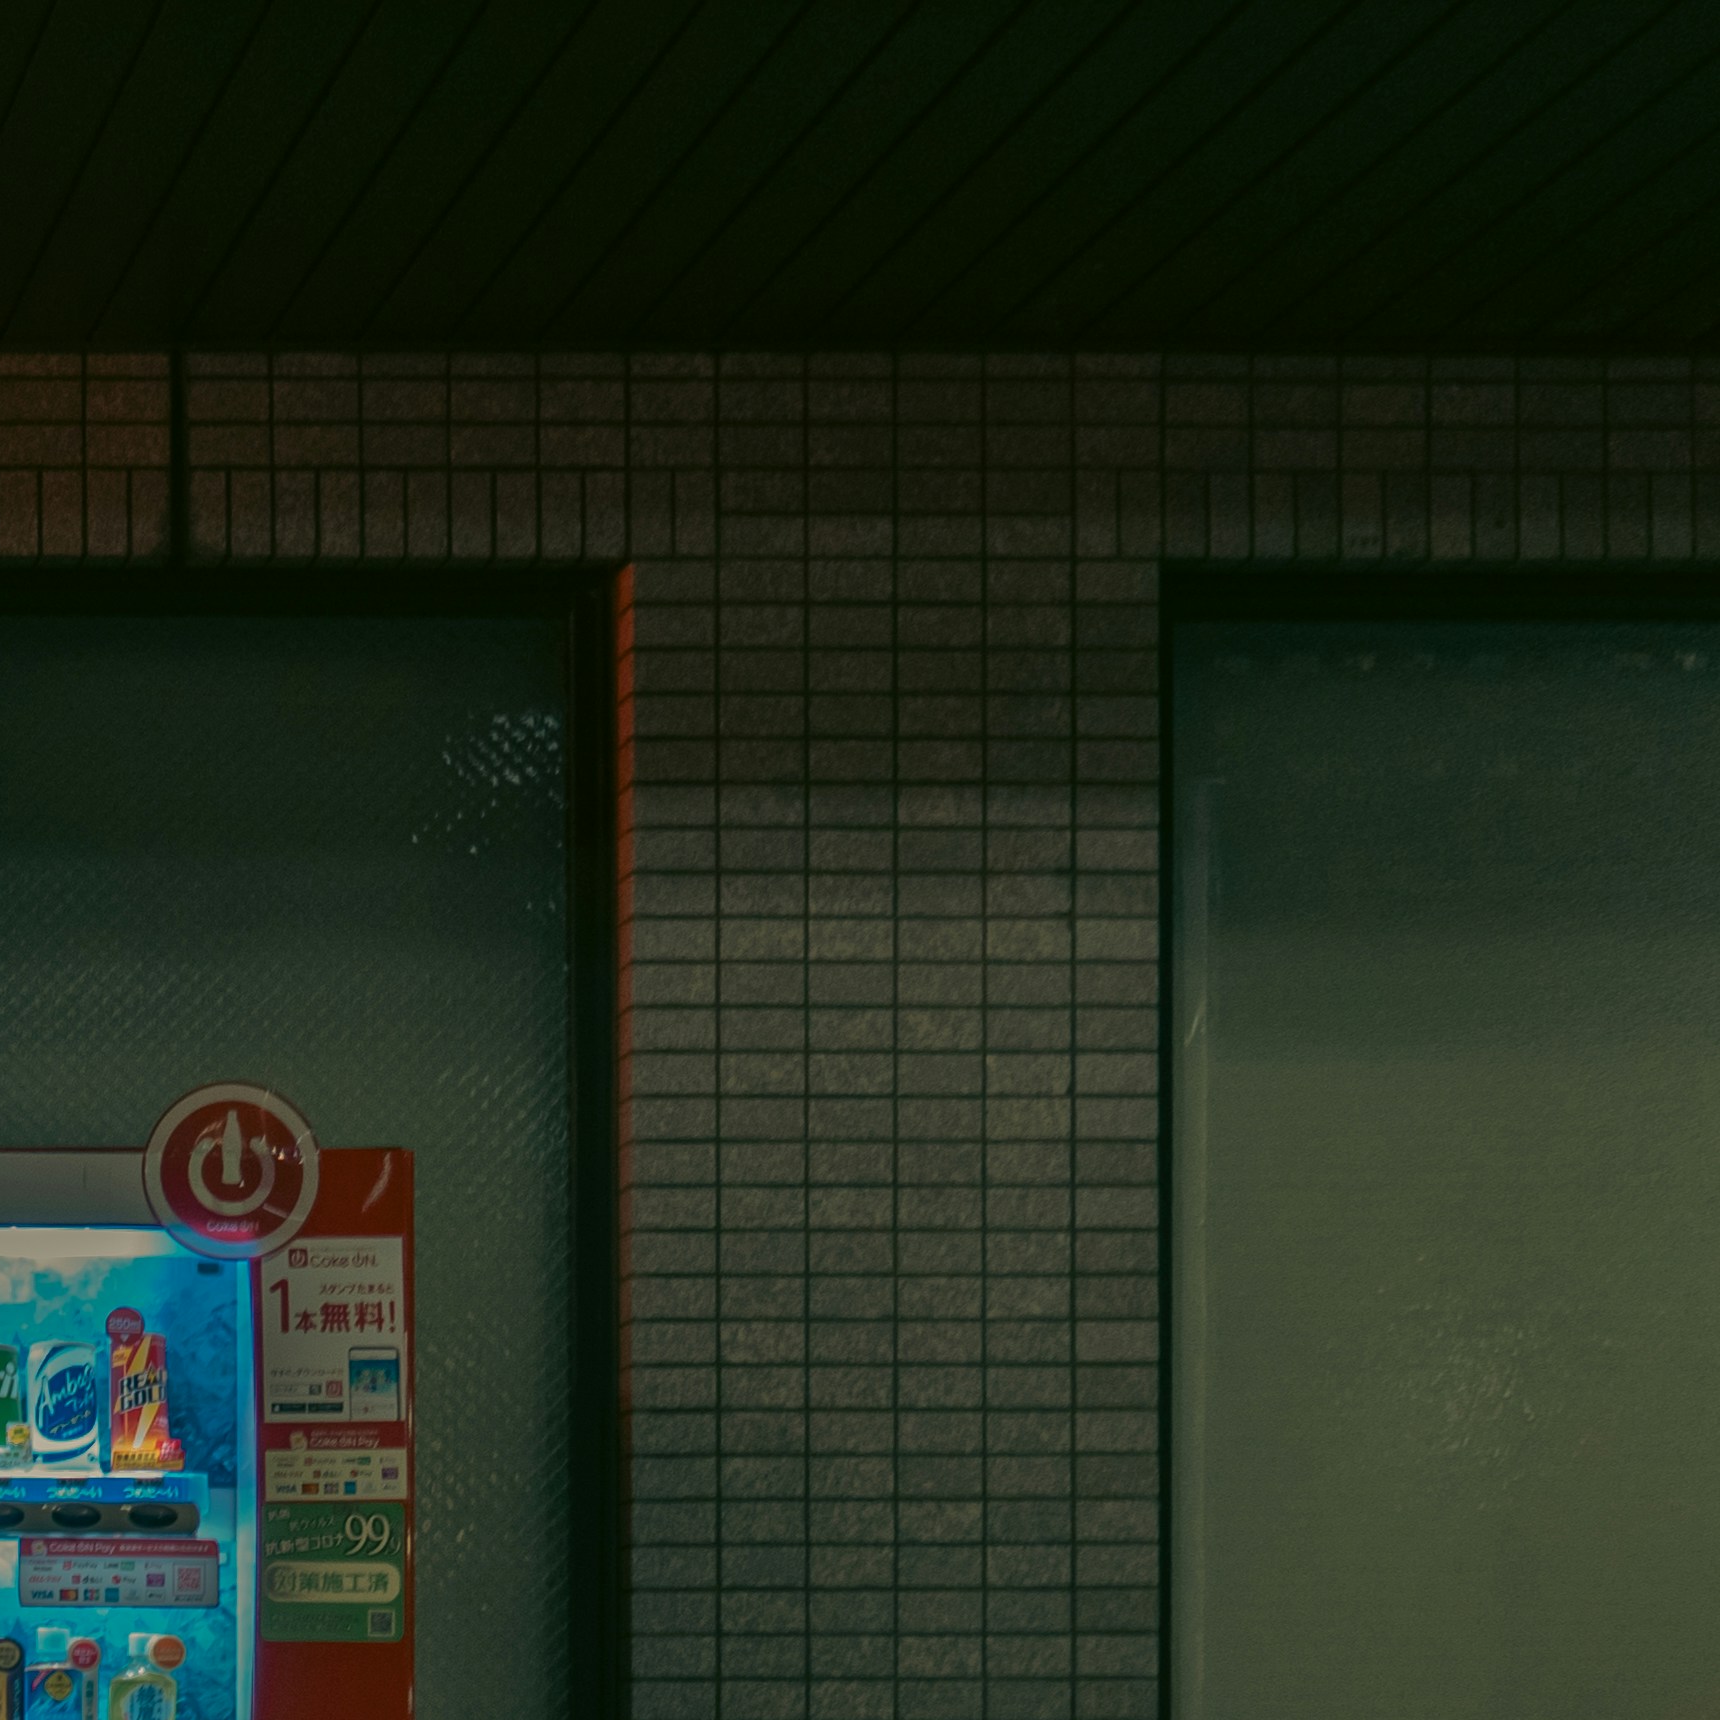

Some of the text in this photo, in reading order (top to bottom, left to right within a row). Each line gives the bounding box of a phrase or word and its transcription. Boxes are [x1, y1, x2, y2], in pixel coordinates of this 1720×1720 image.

[269, 1278, 396, 1334] 1本無料!
[109, 1318, 141, 1331] 250ml
[120, 1385, 166, 1412] GOLD
[273, 1567, 389, 1594] 対策施工済
